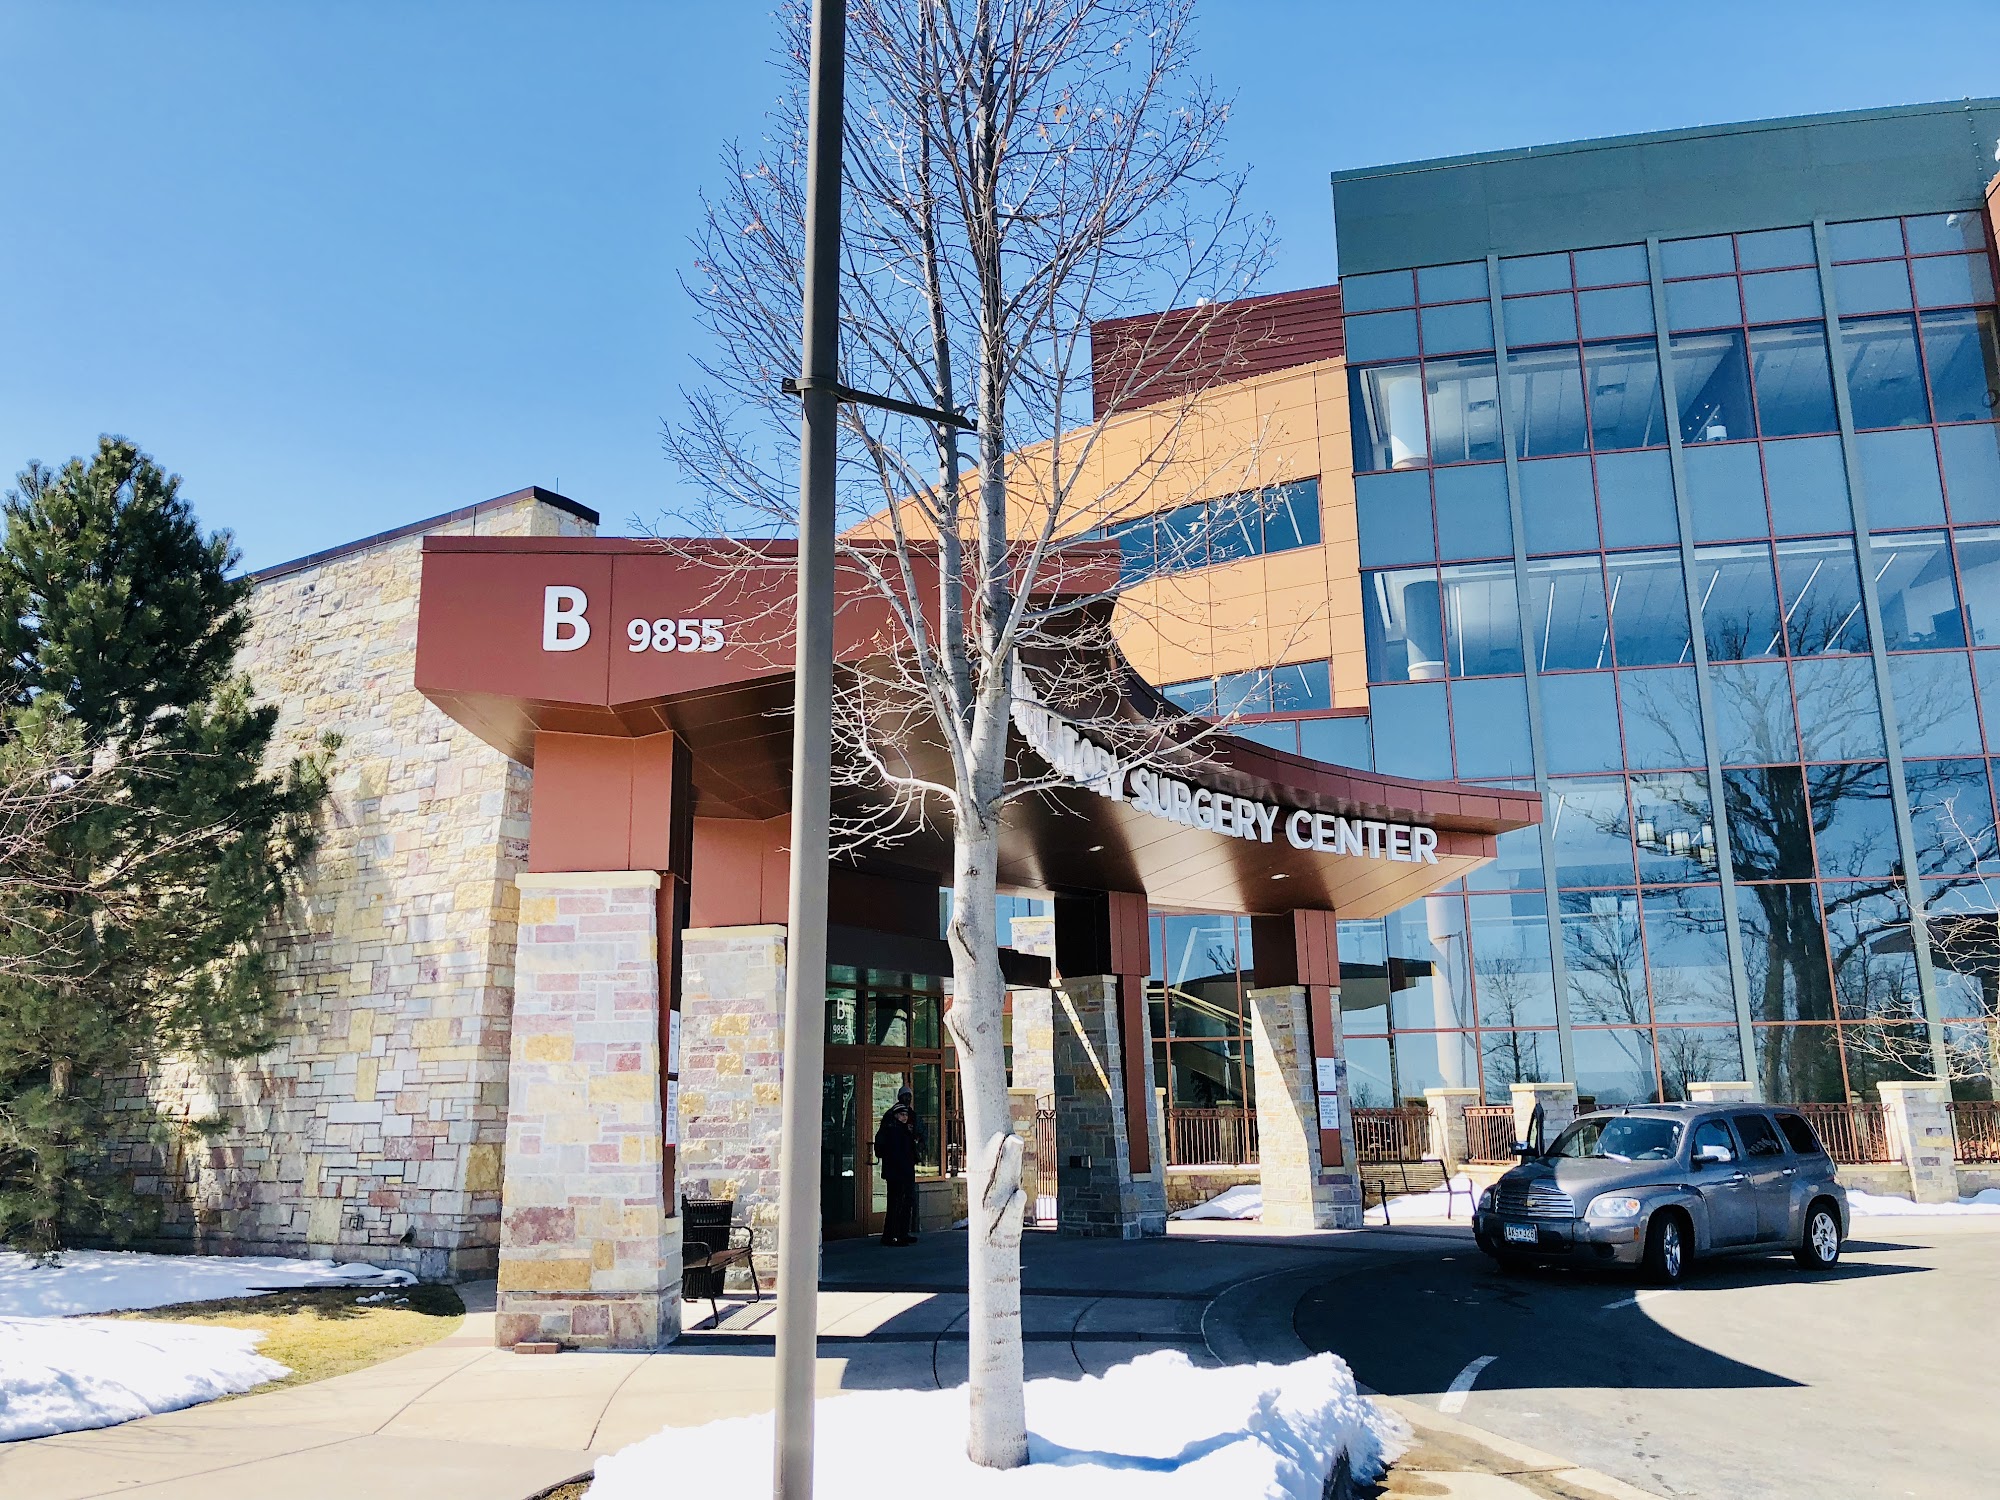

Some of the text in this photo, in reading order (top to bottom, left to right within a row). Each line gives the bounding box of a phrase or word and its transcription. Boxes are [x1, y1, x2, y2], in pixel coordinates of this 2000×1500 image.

[542, 584, 592, 652] B
[626, 618, 726, 653] 9855
[1130, 767, 1280, 844] SURGERY
[1285, 809, 1440, 865] CENTER
